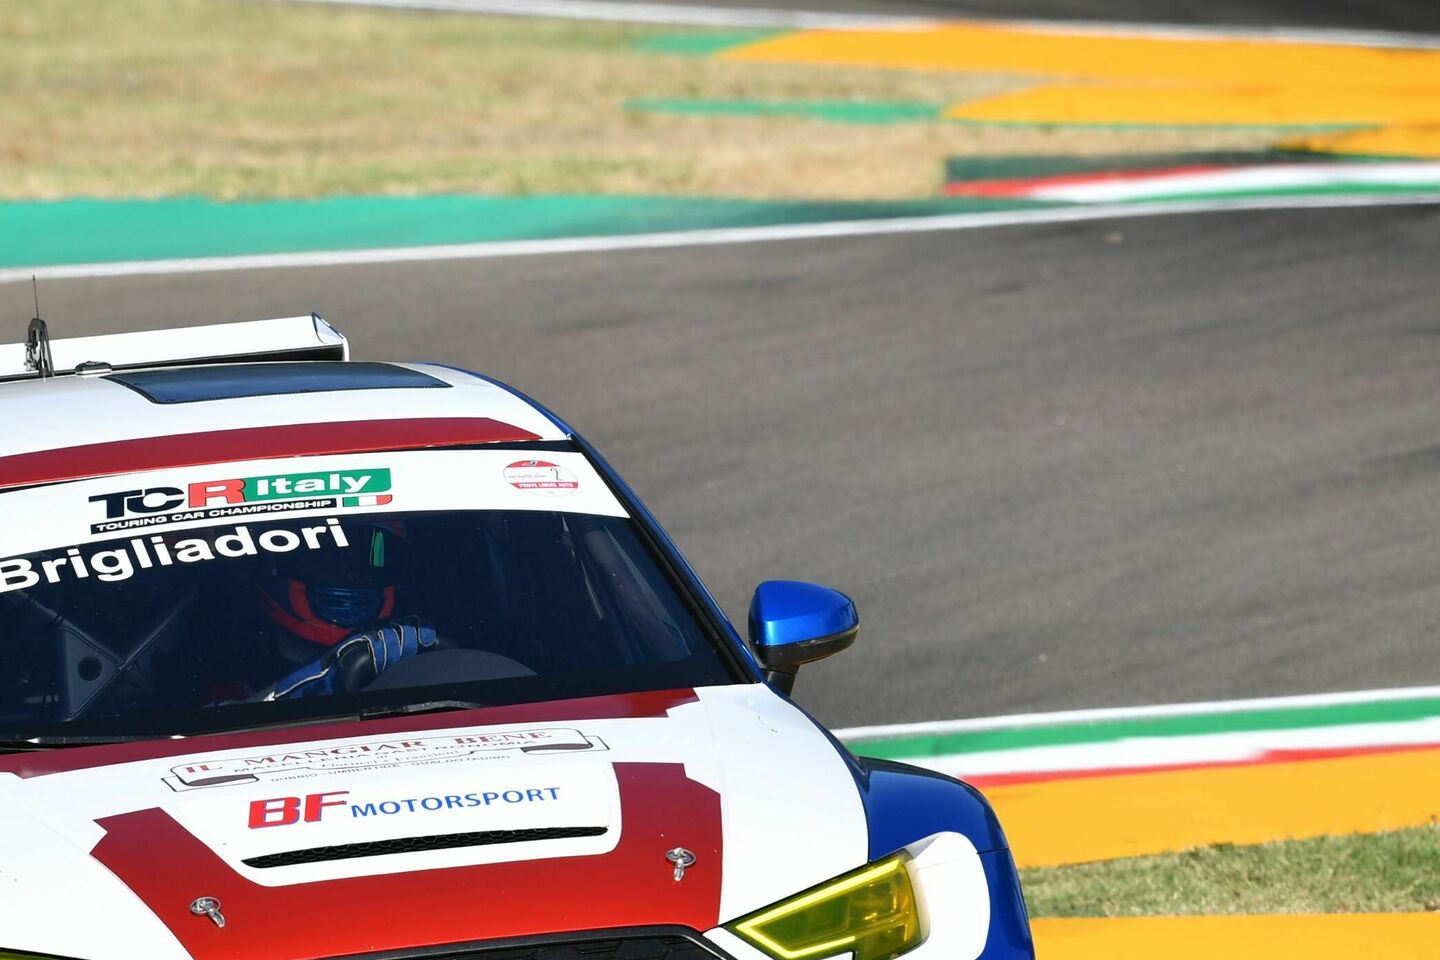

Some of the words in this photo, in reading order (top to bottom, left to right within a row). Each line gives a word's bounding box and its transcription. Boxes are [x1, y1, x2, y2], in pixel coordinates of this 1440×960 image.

[88, 479, 246, 519] TCR
[257, 473, 372, 496] Italy
[96, 515, 168, 532] TOURING
[171, 510, 205, 522] CAR
[208, 499, 332, 518] CHAMPIONSHIP
[185, 764, 224, 774] IL
[243, 741, 427, 766] MANGIAR
[453, 731, 552, 745] BENE
[248, 791, 350, 829] BF
[351, 787, 561, 818] MOTORSPORT
